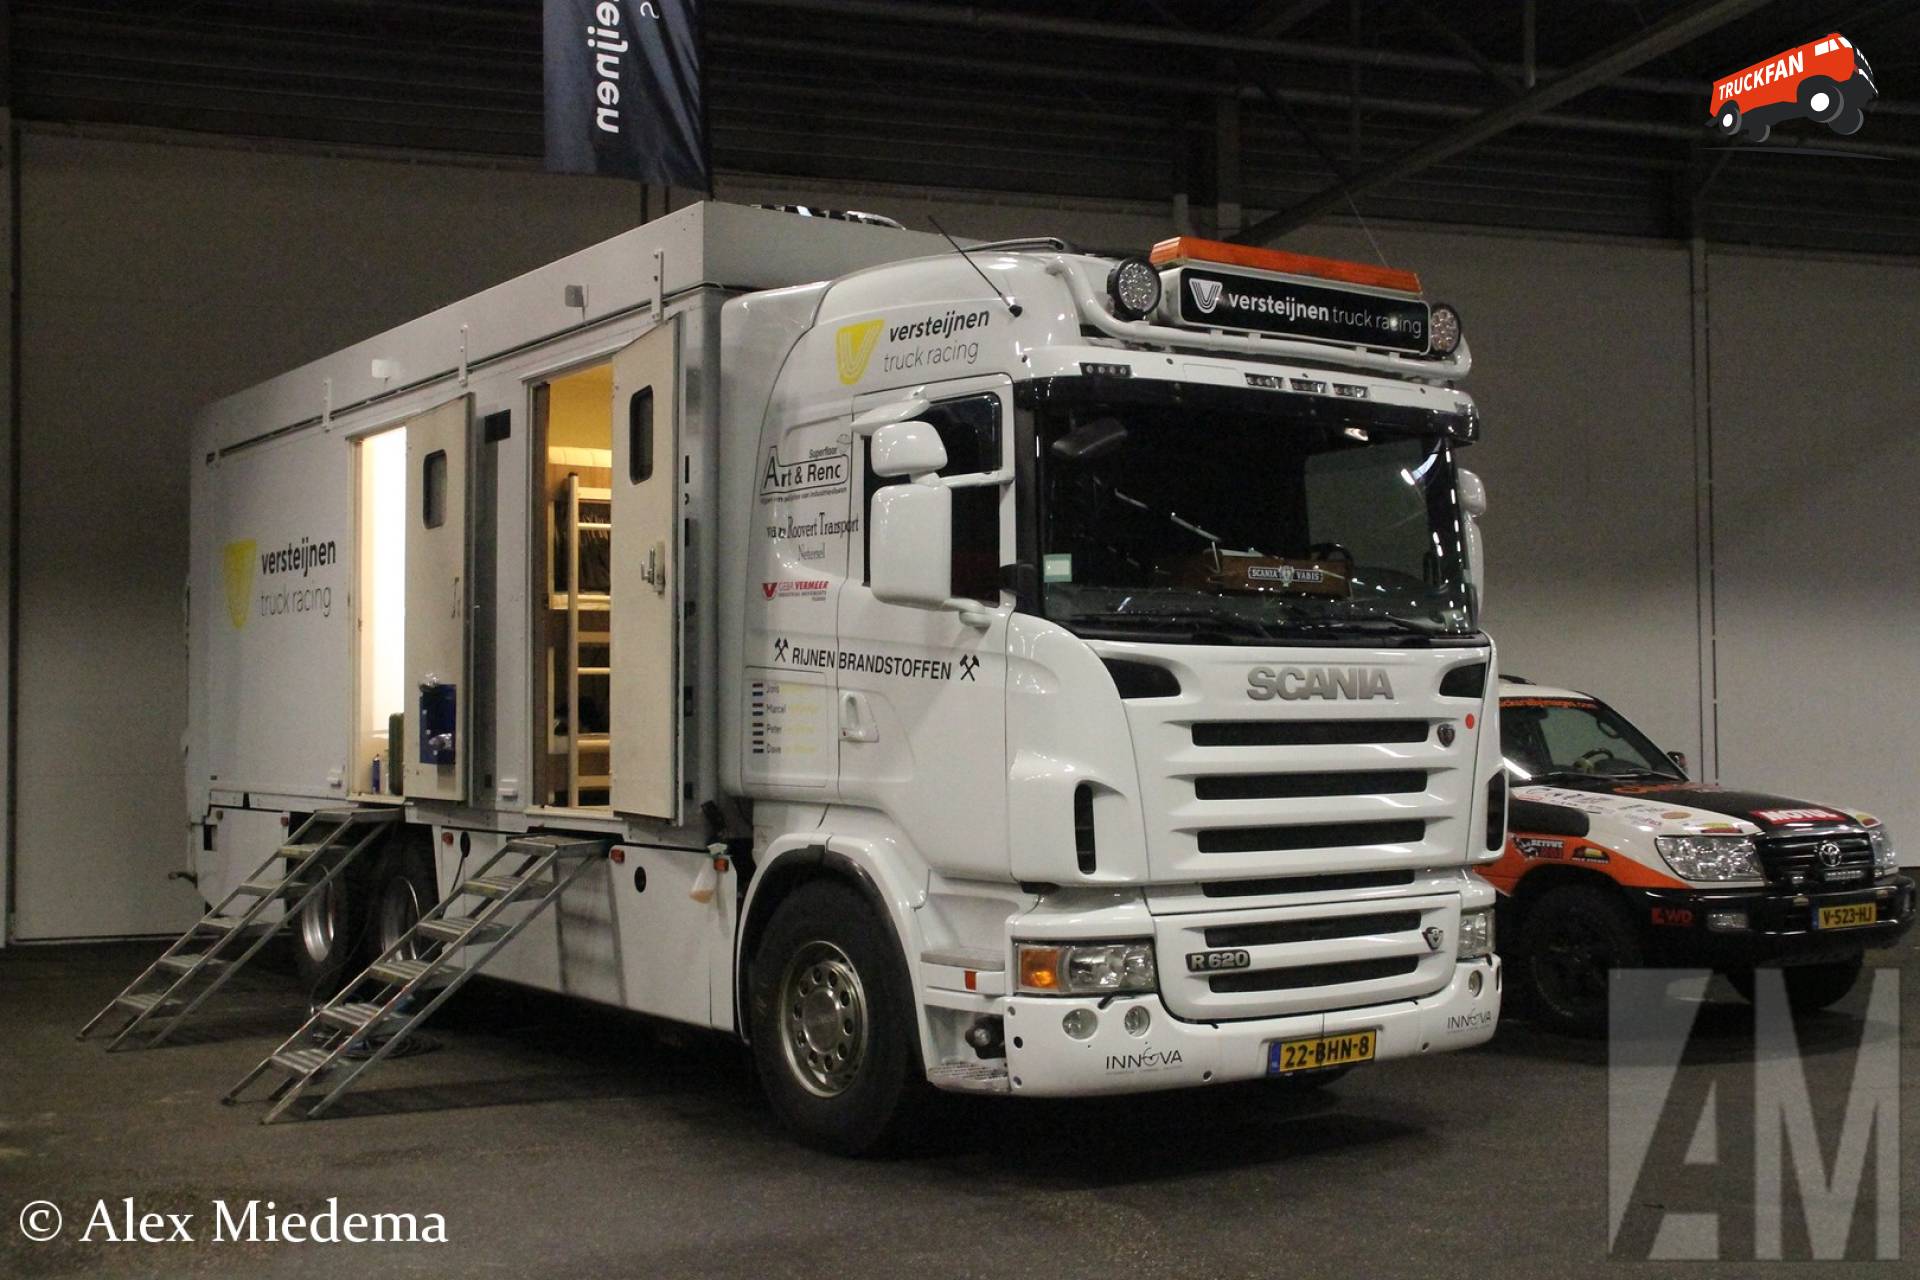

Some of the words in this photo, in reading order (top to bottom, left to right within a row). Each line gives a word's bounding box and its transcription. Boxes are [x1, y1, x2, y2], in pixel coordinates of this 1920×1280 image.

[889, 309, 990, 343] versteijnen
[1228, 292, 1330, 323] versteijnen
[1332, 308, 1373, 327] truck
[884, 344, 924, 373] truck
[926, 340, 979, 364] racing
[763, 455, 793, 489] Art
[795, 465, 803, 485] &
[262, 536, 337, 578] versteijnen
[260, 584, 291, 616] truck
[292, 580, 332, 618] racing
[792, 647, 836, 669] RIJNEN
[838, 651, 953, 681] BRANDSTOFFEN
[1246, 666, 1395, 702] SCANIA
[1191, 954, 1205, 970] R
[1208, 951, 1249, 969] 620
[1105, 1046, 1184, 1070] INNOVA
[1284, 1035, 1371, 1068] 22-BHN-8
